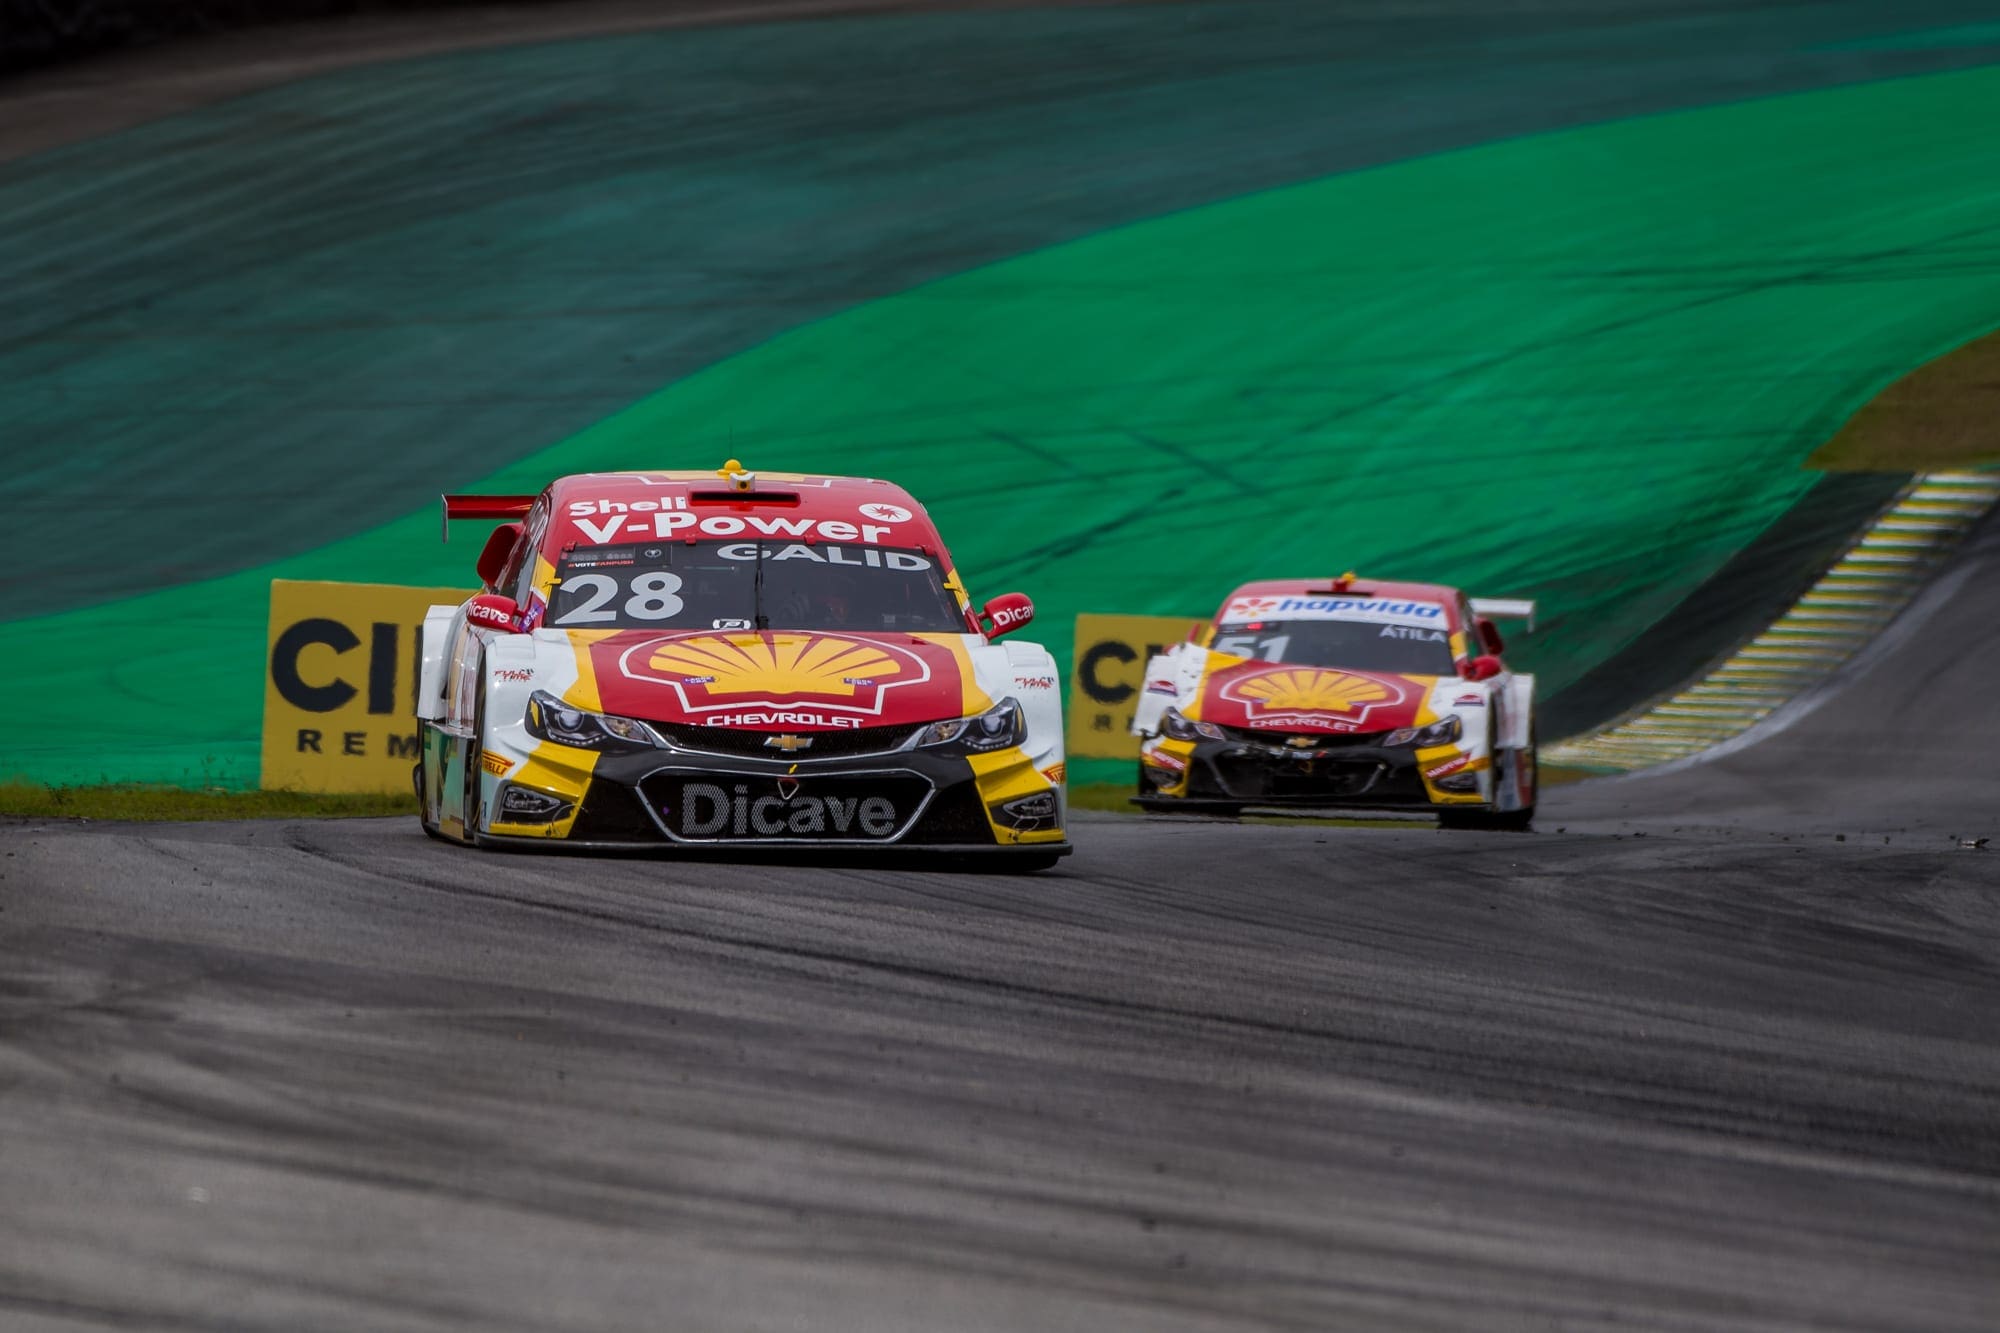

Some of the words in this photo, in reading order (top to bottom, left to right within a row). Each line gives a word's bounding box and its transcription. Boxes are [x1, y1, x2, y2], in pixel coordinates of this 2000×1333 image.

[569, 496, 686, 517] Shell
[572, 511, 891, 544] V-Power
[717, 543, 931, 571] GALID
[554, 571, 684, 625] 28
[1279, 599, 1442, 619] hapvida
[1380, 624, 1446, 643] ÁTILA
[1215, 635, 1290, 664] 51
[272, 618, 422, 716] CI
[707, 712, 864, 729] CHEVROLET
[1250, 717, 1358, 732] CHEVROLET
[682, 783, 896, 836] Dicave
